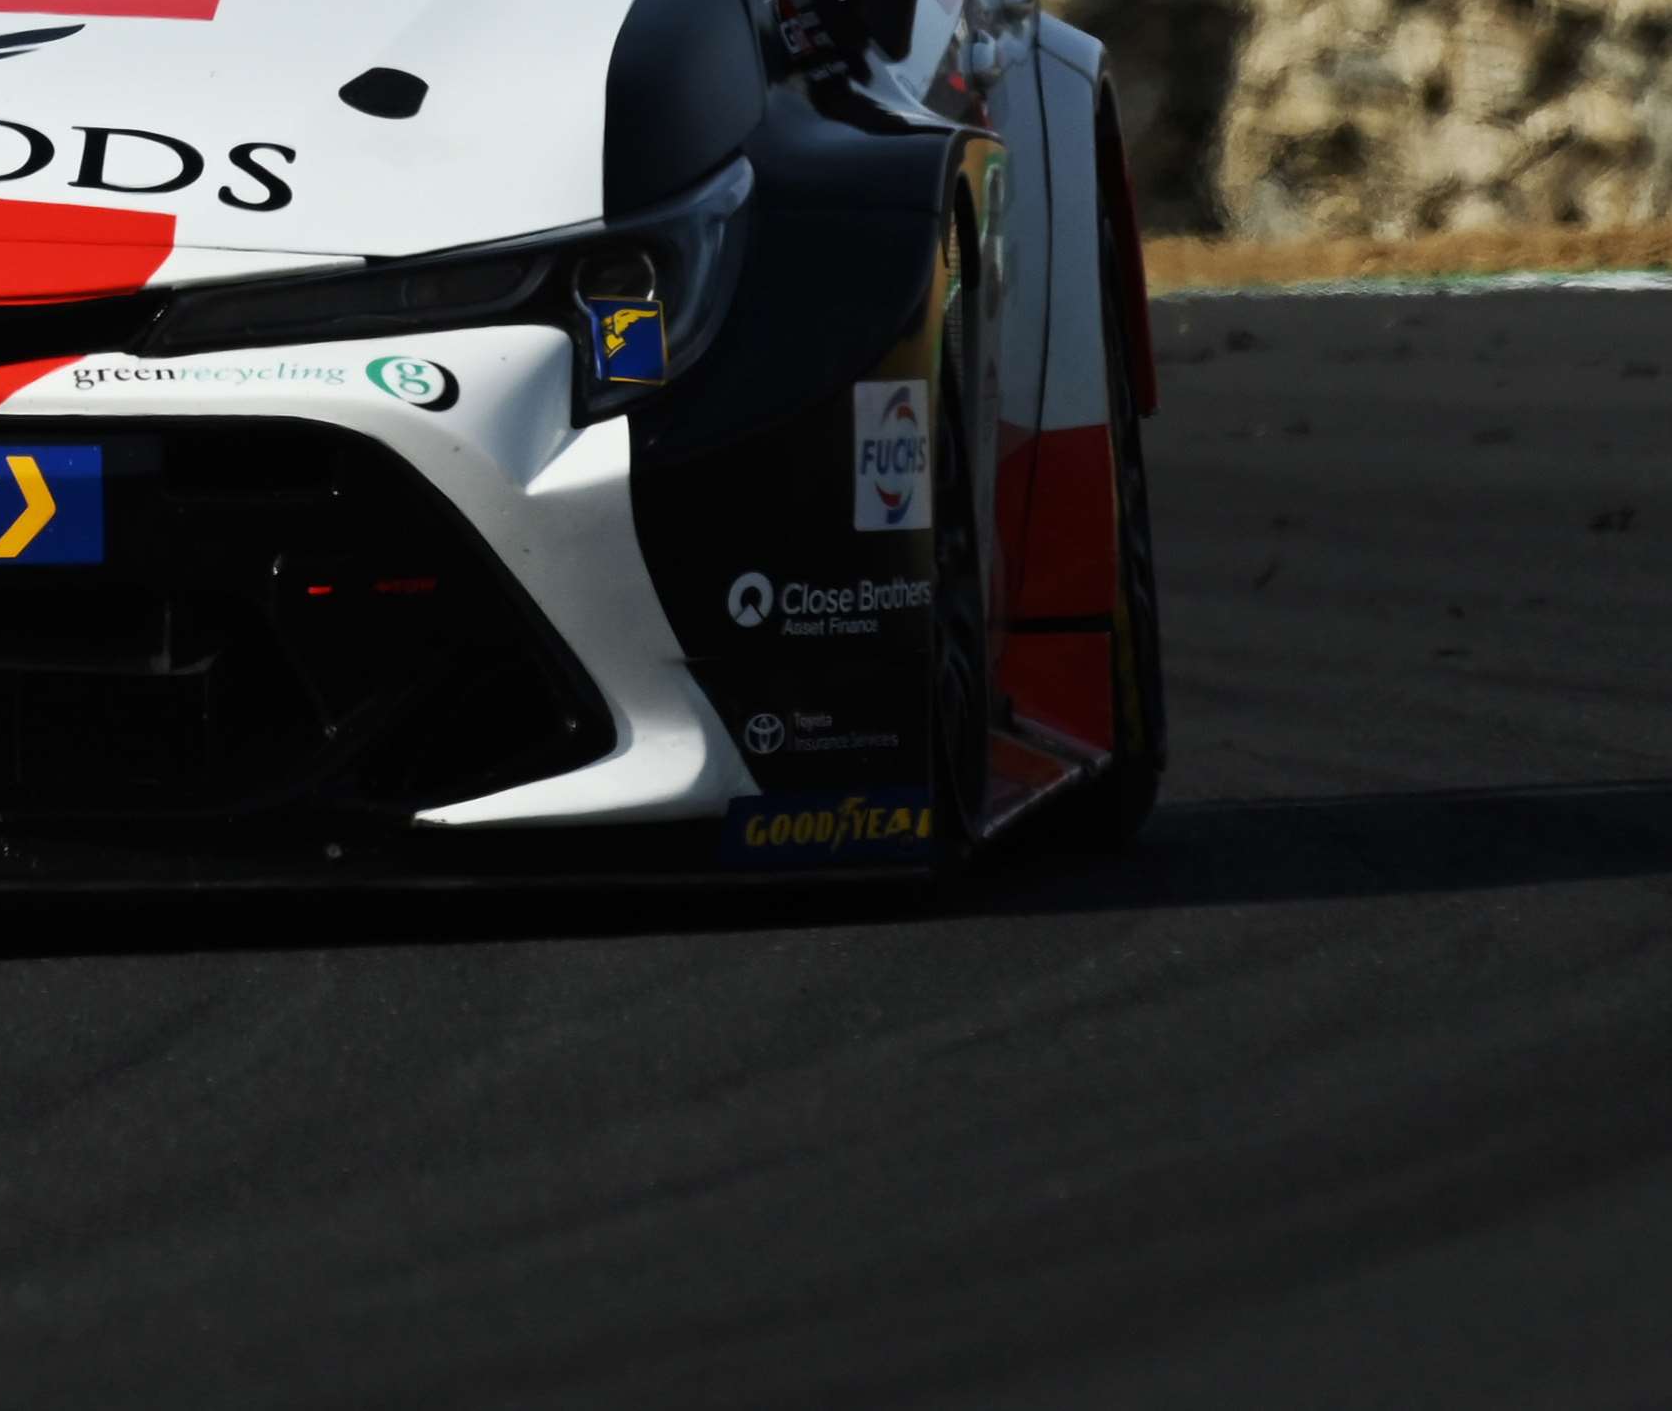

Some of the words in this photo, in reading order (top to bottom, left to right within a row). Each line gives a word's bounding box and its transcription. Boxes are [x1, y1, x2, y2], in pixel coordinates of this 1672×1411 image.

[74, 361, 348, 390] greenrecycling
[861, 440, 927, 477] FUCHS
[781, 583, 854, 614] Close
[860, 579, 931, 612] Brothers
[782, 618, 825, 636] Asset
